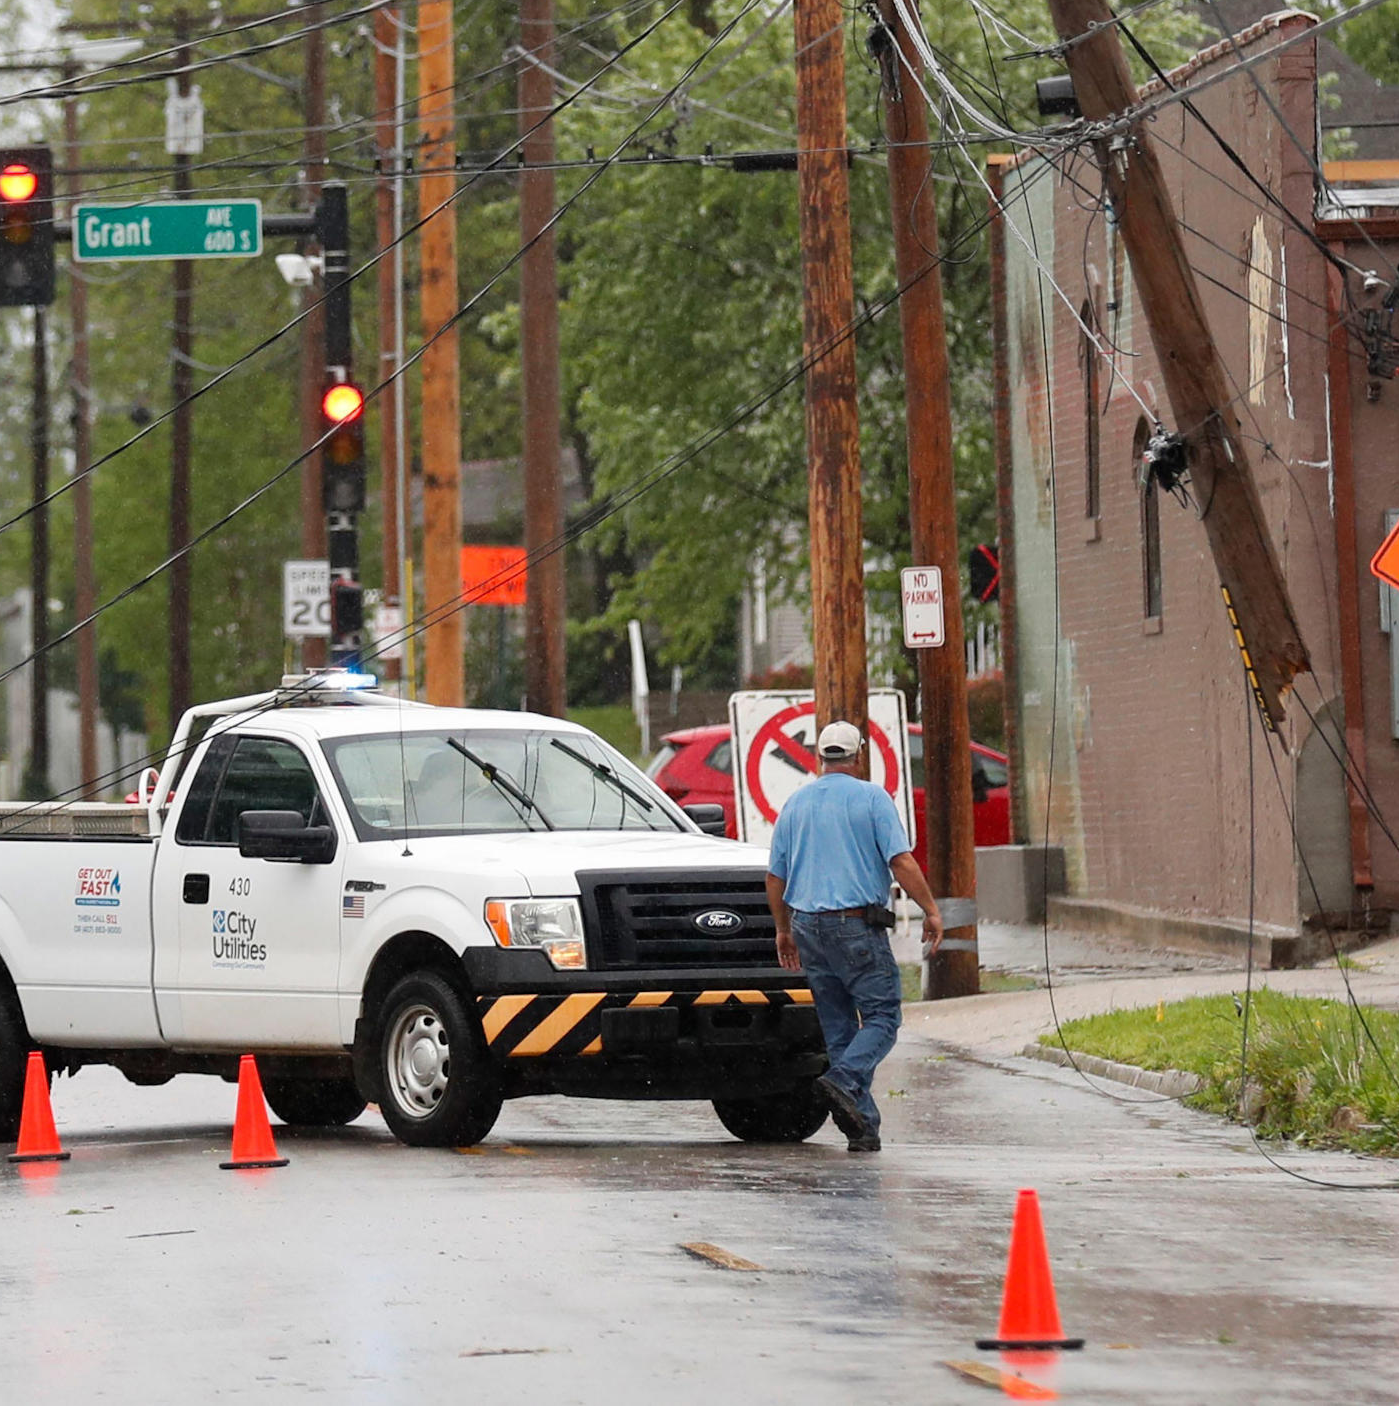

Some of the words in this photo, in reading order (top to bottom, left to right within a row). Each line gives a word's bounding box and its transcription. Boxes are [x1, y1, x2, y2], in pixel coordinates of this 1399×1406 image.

[206, 206, 233, 227] AVE
[85, 215, 152, 249] Grant
[240, 229, 251, 251] S
[913, 573, 928, 588] NO
[905, 590, 939, 604] PARKING
[292, 600, 333, 625] 20
[78, 868, 93, 879] GET
[95, 868, 112, 879] OUT
[80, 881, 110, 896] FAST
[229, 877, 251, 896] 430
[106, 914, 118, 924] 911
[227, 911, 257, 942] City
[708, 914, 733, 926] Ford
[213, 936, 267, 961] Utilities
